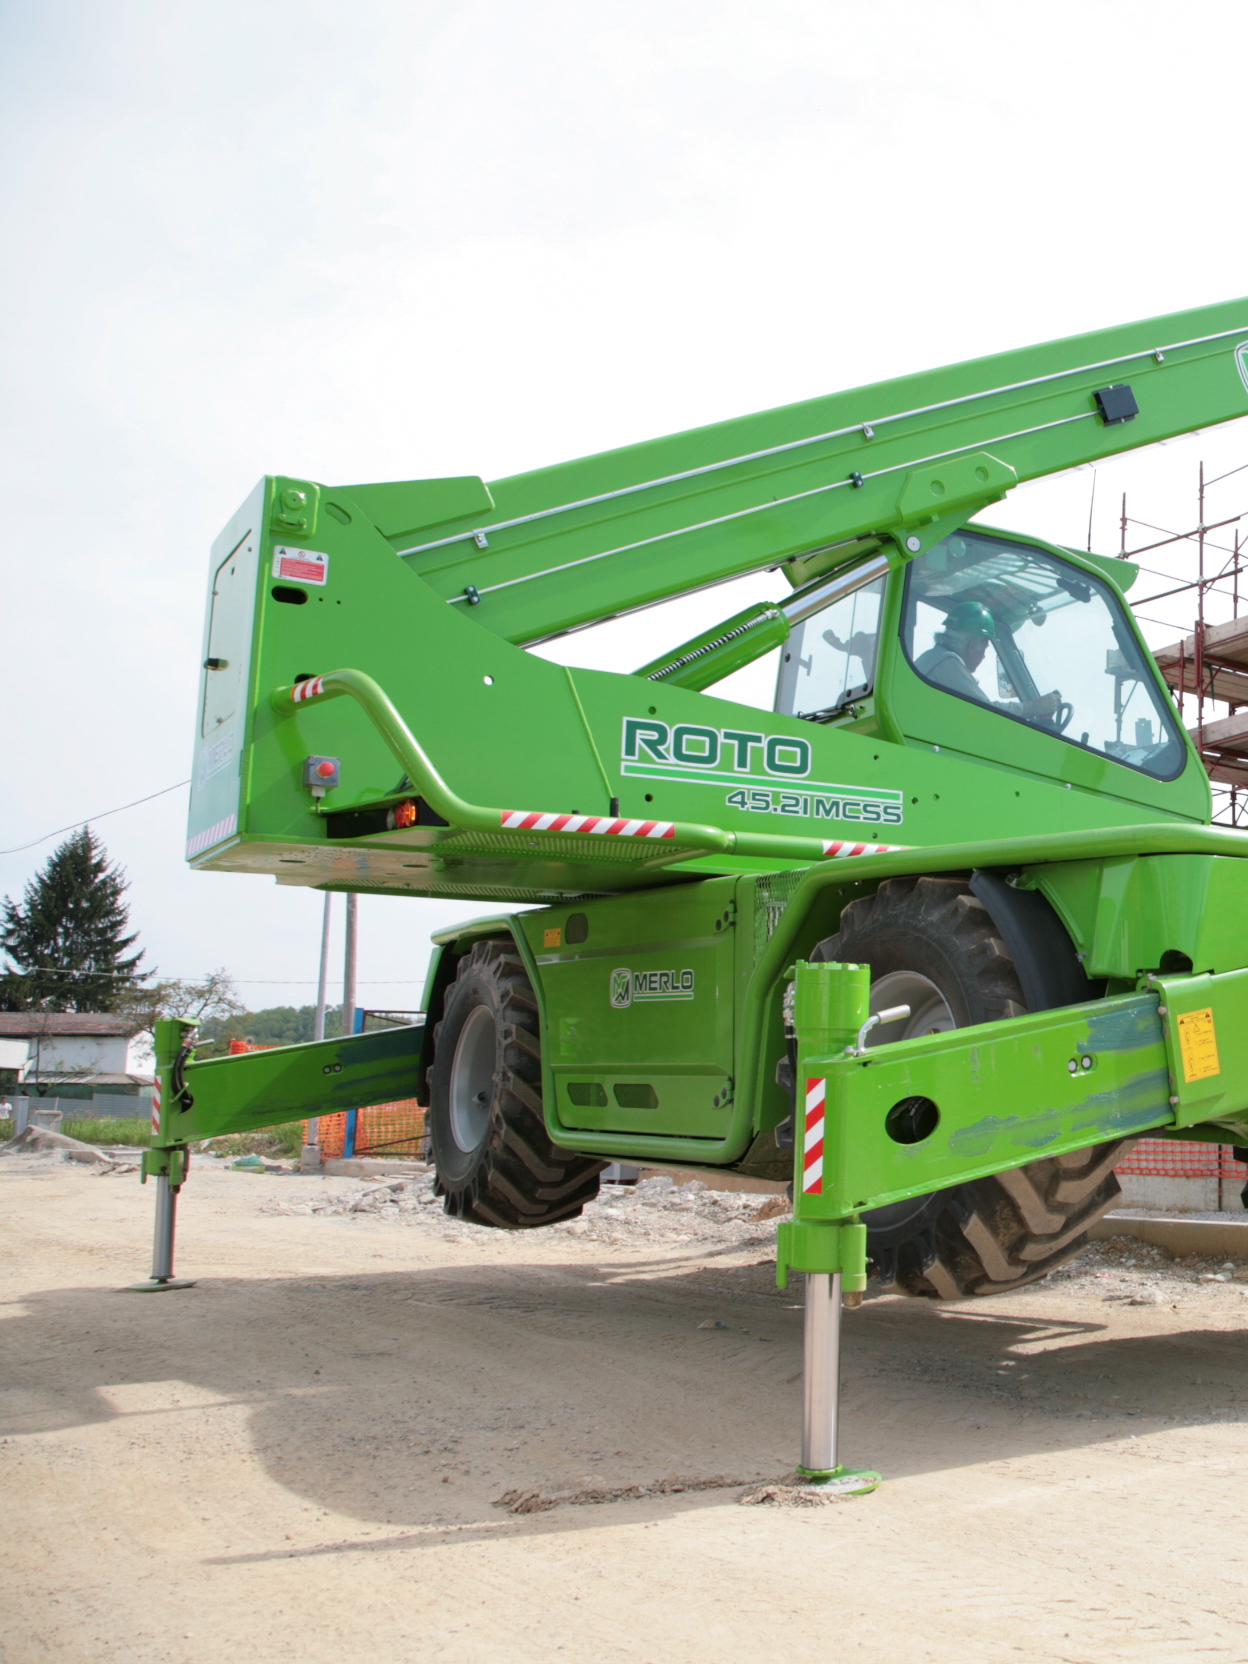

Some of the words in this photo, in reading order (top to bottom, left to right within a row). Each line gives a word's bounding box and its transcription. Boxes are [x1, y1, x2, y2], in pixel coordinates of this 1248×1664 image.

[622, 717, 811, 777] ROTO
[726, 789, 809, 817] 45.21
[814, 798, 903, 824] MCSS
[633, 968, 694, 993] MERLO
